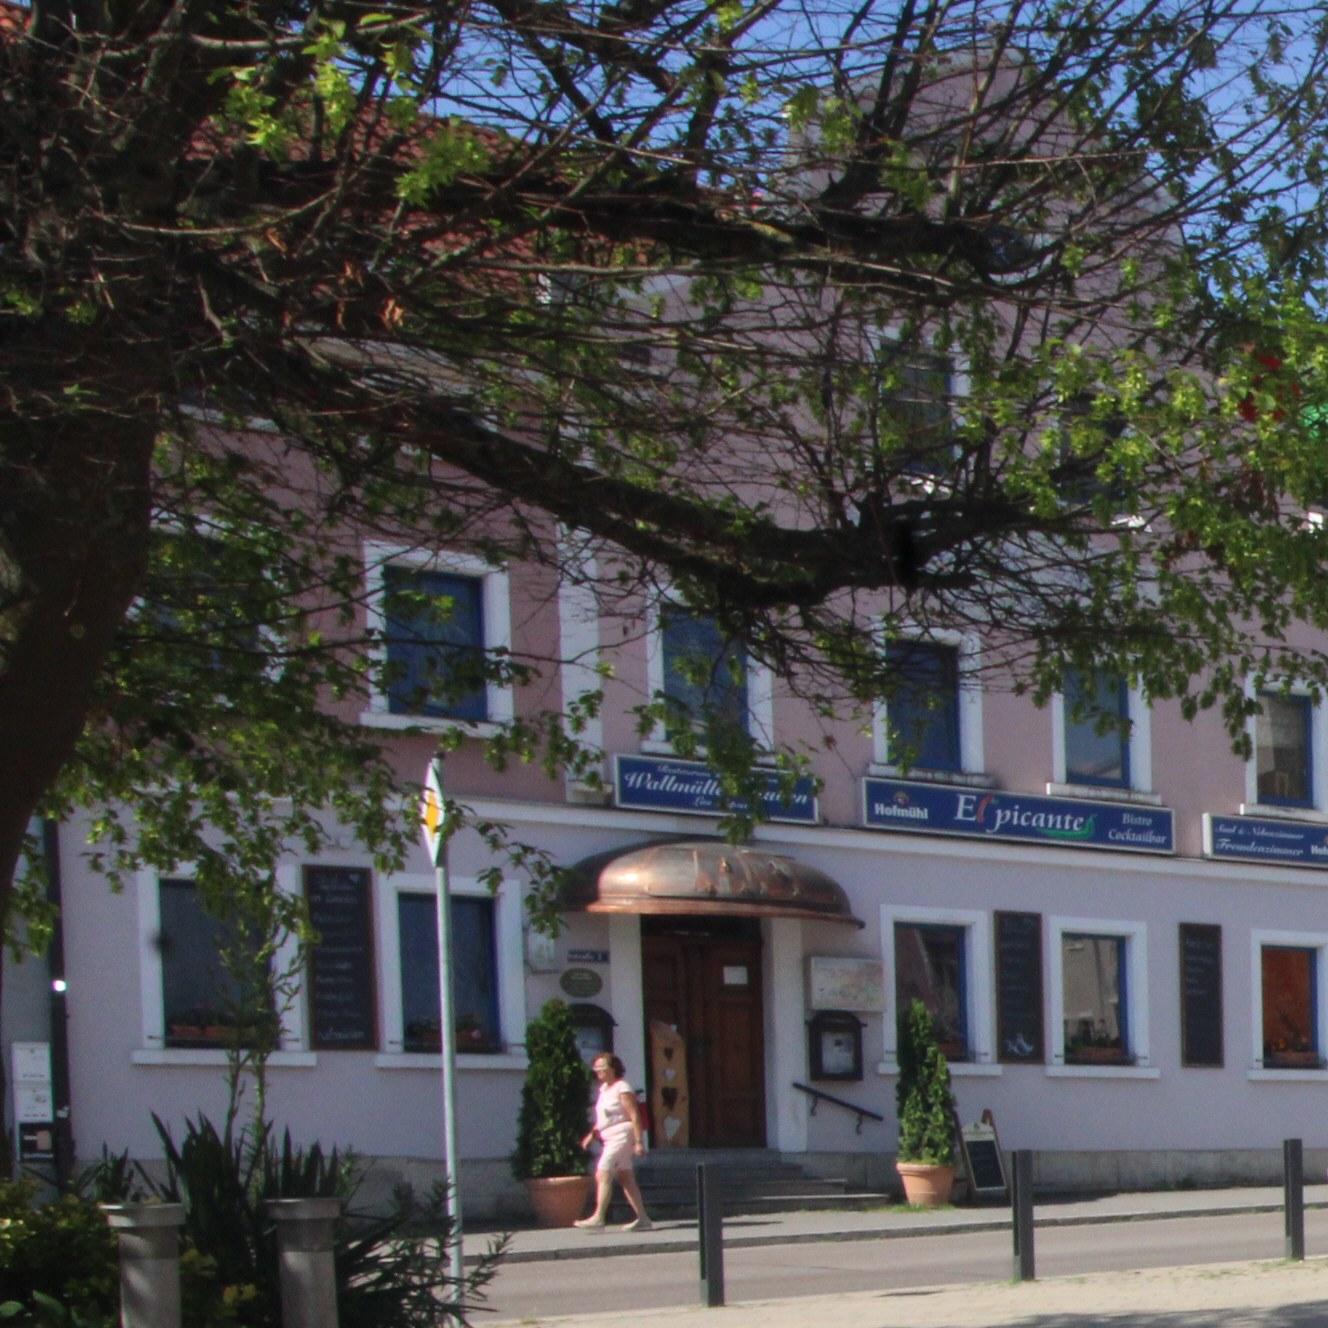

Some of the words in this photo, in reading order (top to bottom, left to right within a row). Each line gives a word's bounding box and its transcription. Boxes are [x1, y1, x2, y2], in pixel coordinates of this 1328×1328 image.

[875, 802, 929, 820] Hofmühl
[986, 805, 1085, 833] picante
[1122, 813, 1153, 826] Bistro
[1108, 828, 1168, 844] Cocktailbar
